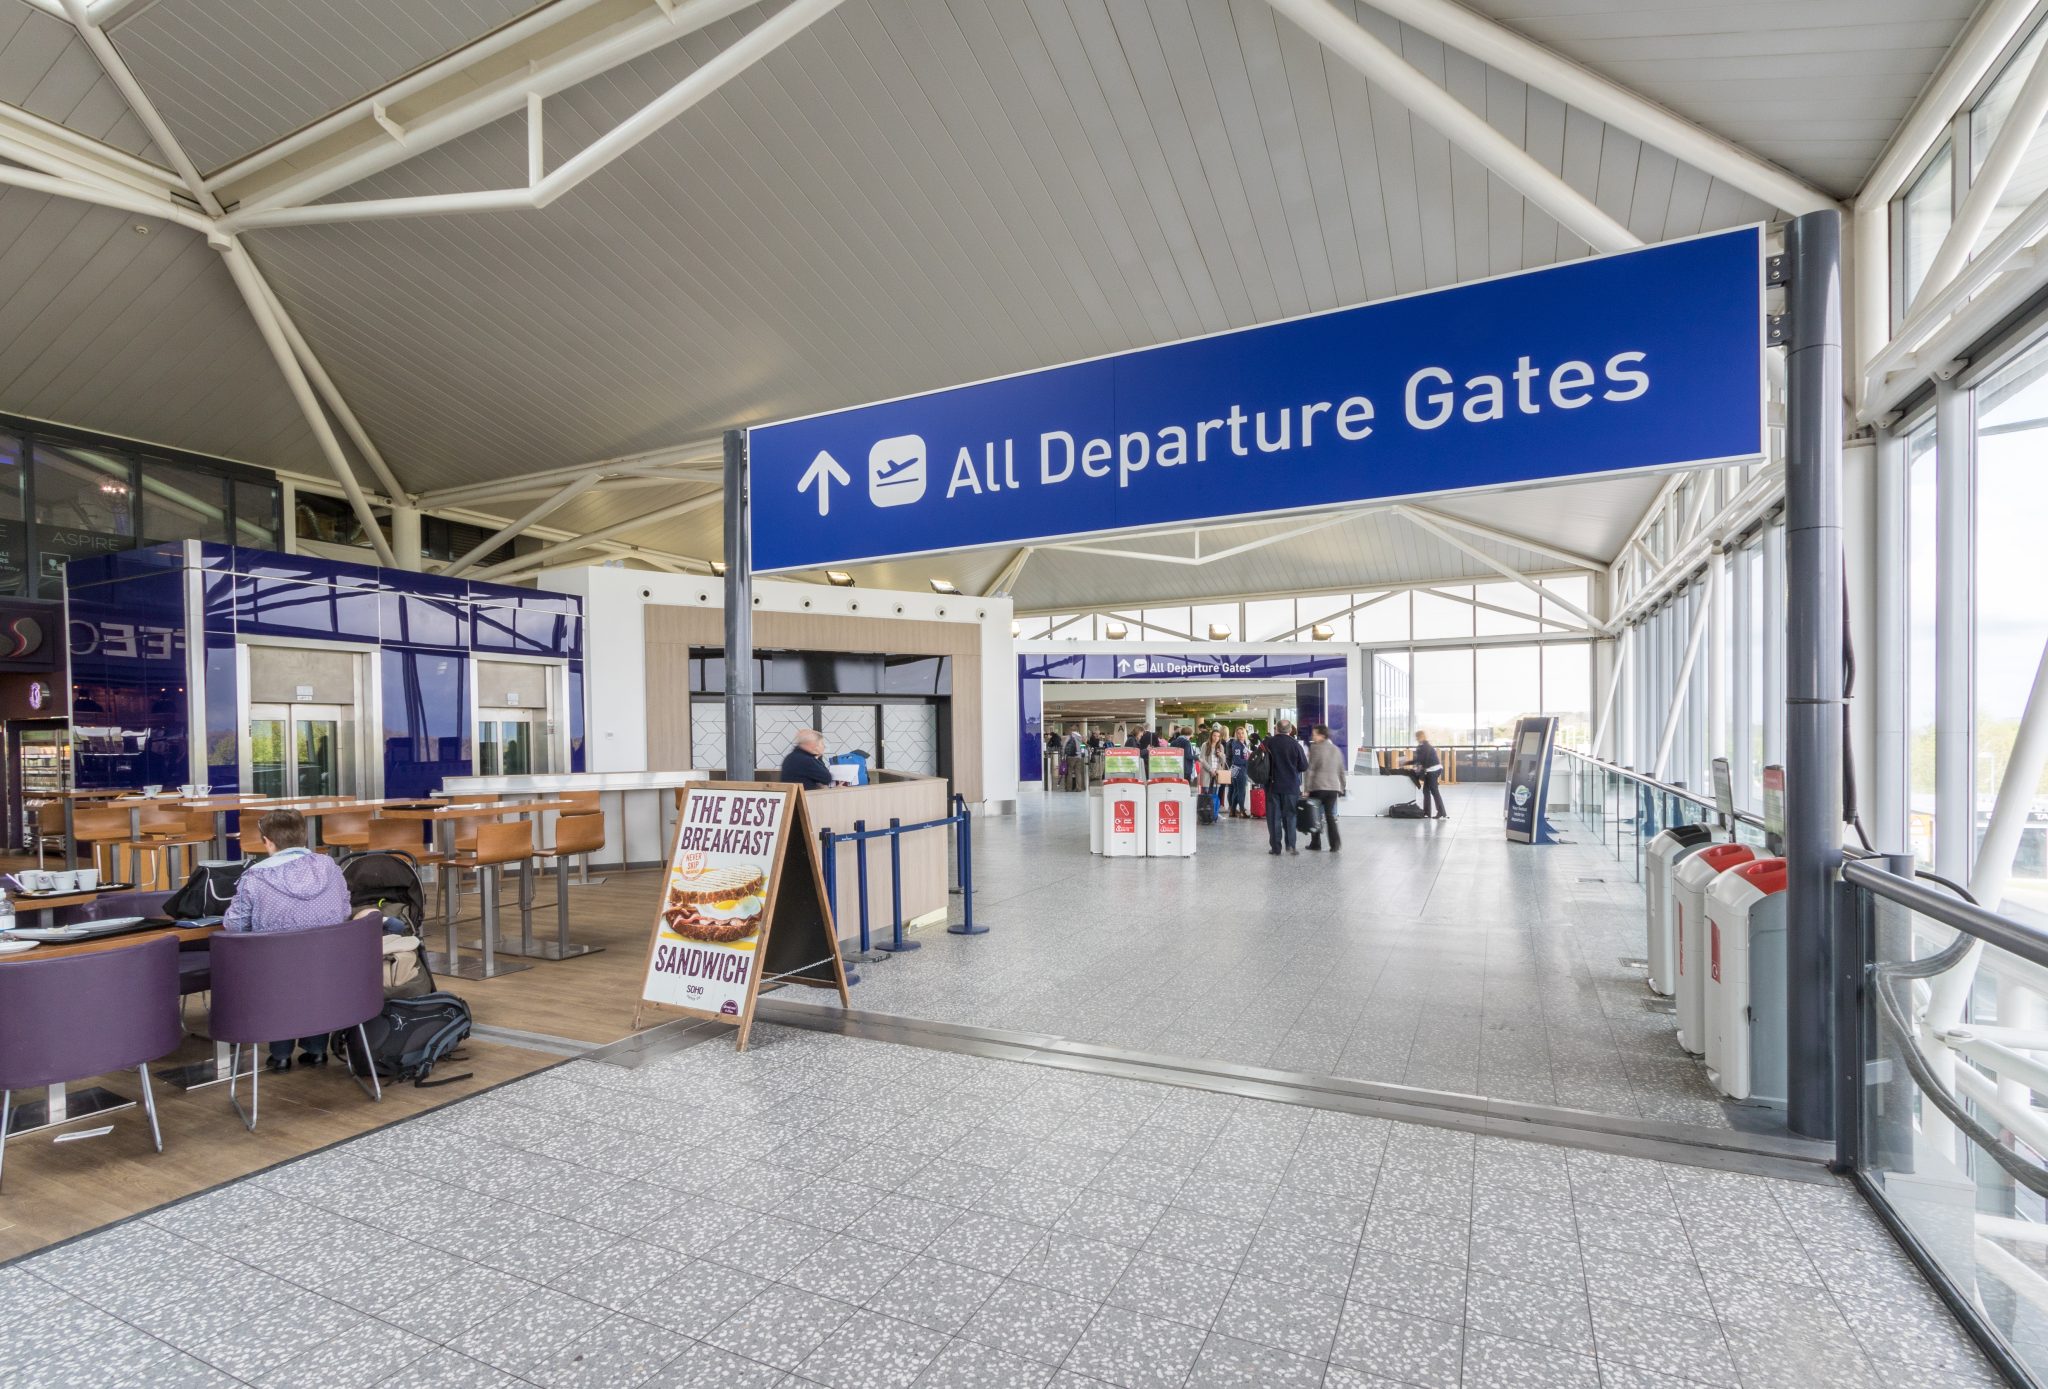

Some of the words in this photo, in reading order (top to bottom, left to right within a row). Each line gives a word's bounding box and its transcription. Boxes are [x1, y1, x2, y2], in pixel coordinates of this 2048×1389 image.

[946, 439, 1020, 498] All
[1040, 396, 1375, 488] Departure
[1404, 351, 1650, 430] Gates
[52, 531, 120, 552] ASPIRE
[1149, 662, 1165, 673] All
[1167, 662, 1220, 675] Departure
[1222, 662, 1251, 673] Gates
[690, 795, 726, 824] THE
[729, 797, 781, 827] BEST
[681, 826, 774, 856] BREAKFAST
[686, 852, 702, 861] NEVER
[687, 861, 699, 870] SKIP
[655, 944, 750, 985] SANDWICH
[686, 984, 704, 995] SOHO
